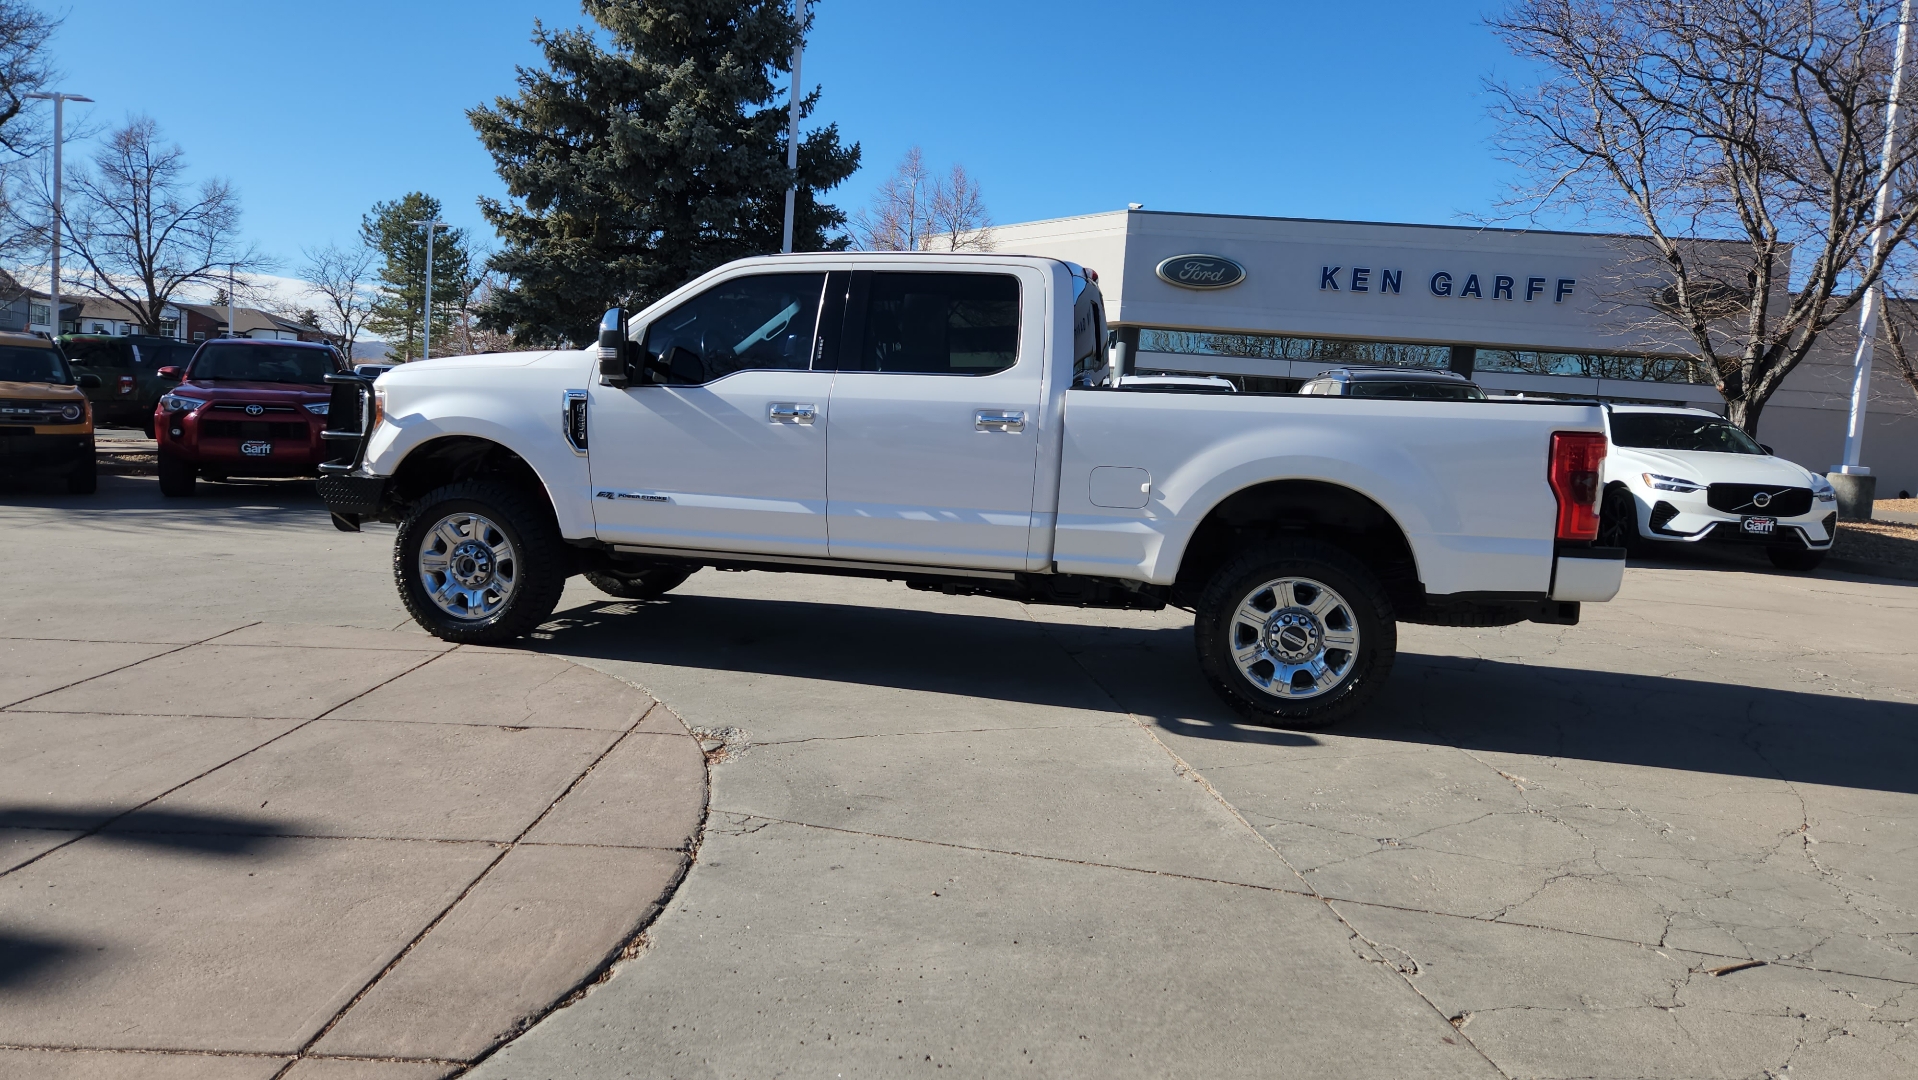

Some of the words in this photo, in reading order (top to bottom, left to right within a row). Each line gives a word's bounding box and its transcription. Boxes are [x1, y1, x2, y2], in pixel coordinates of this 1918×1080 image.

[1179, 261, 1225, 281] Ford
[1320, 266, 1403, 294] KEN
[1429, 271, 1576, 302] GARFF
[241, 443, 271, 454] Garff
[1744, 519, 1774, 531] Garff
